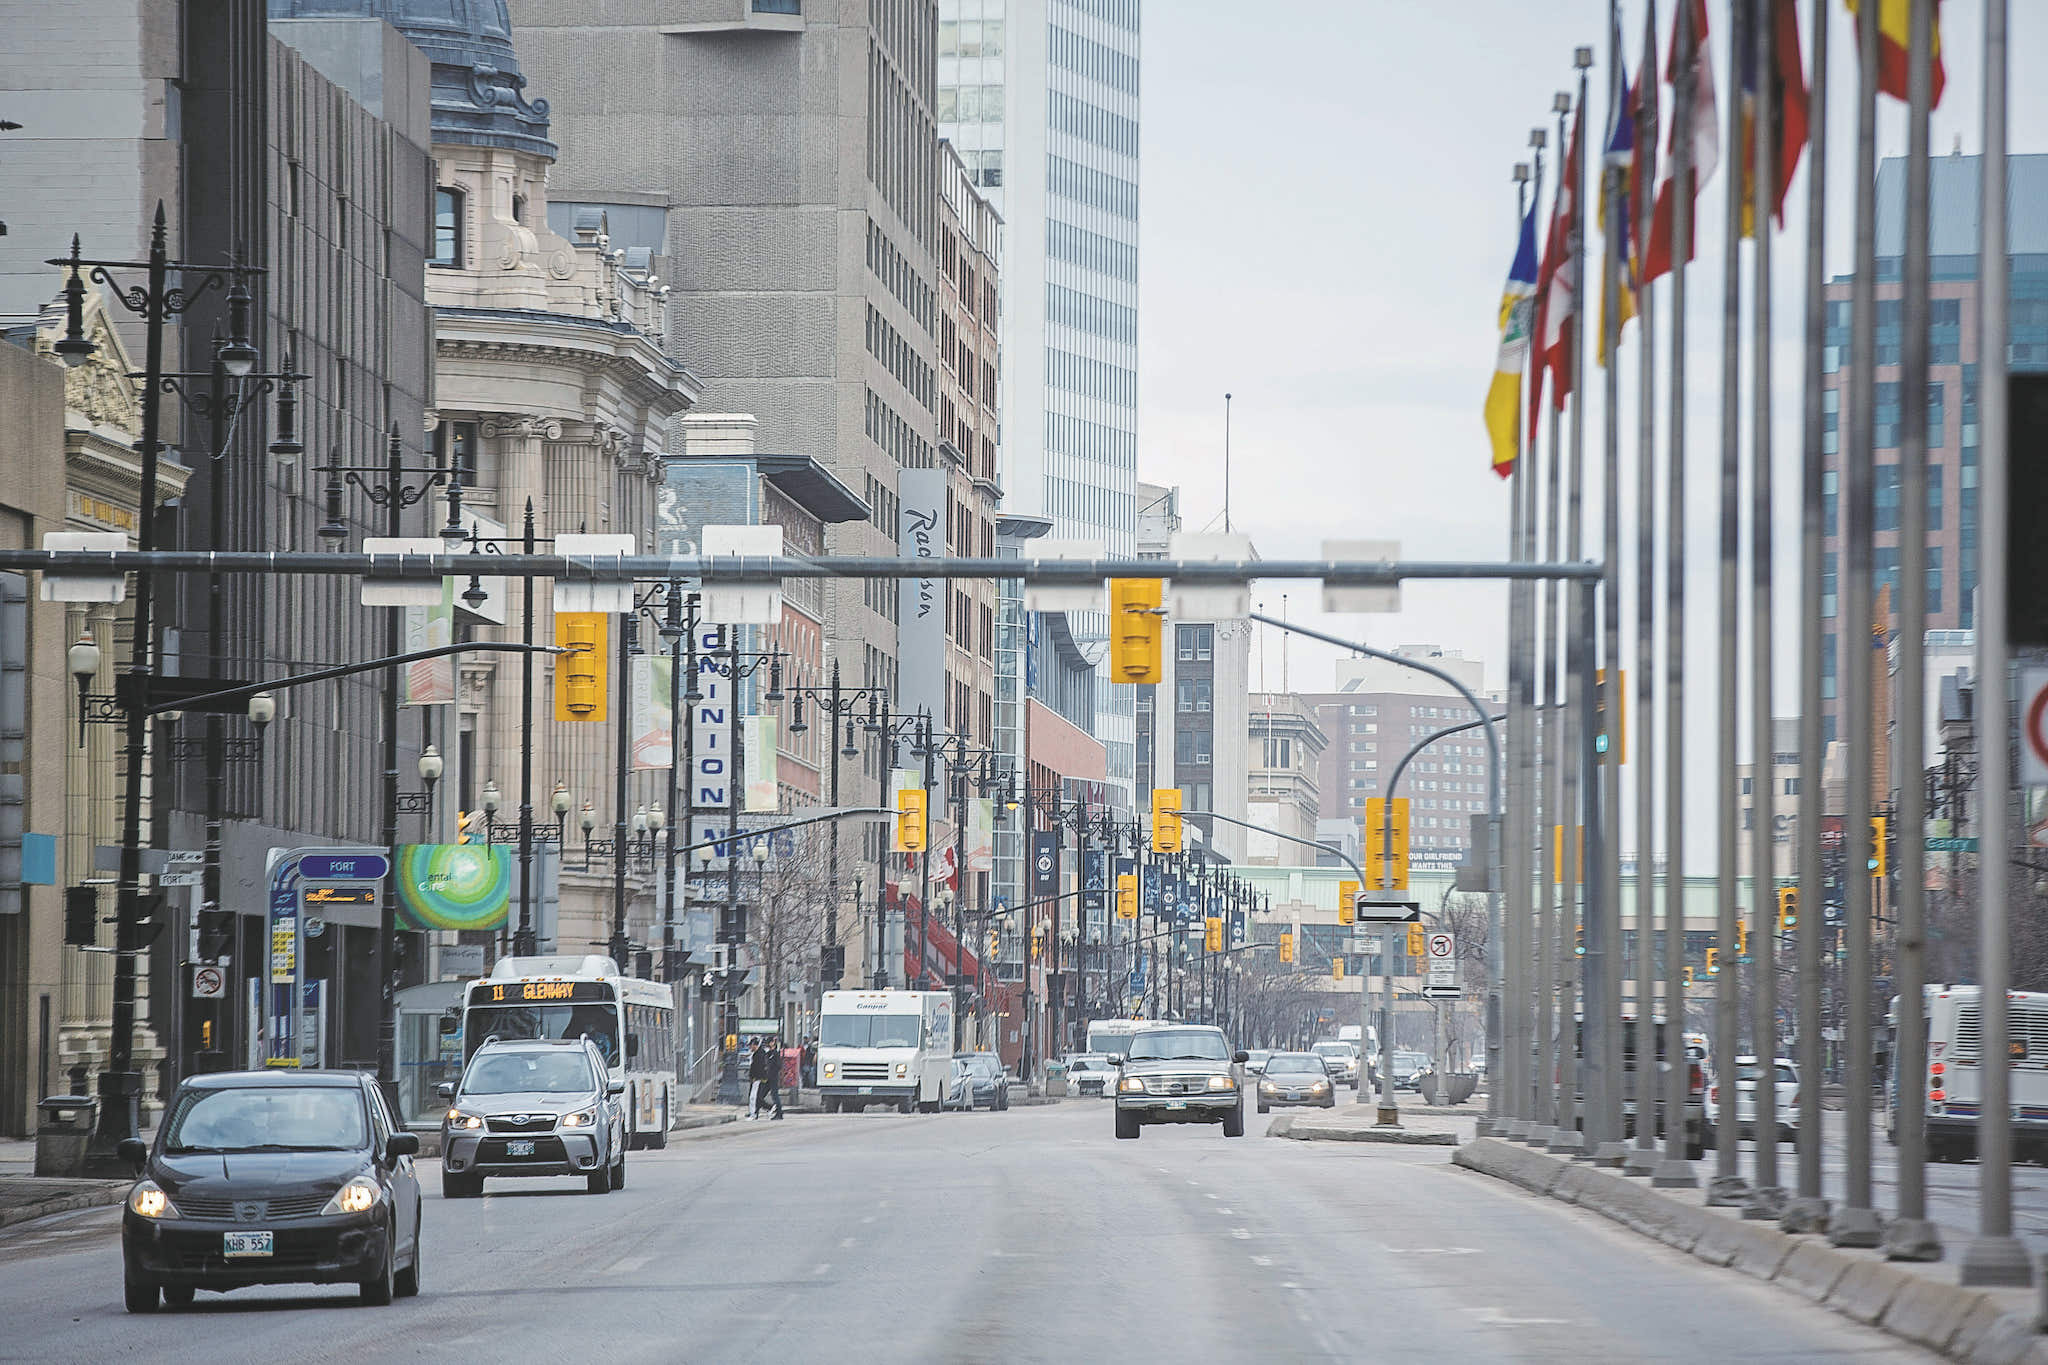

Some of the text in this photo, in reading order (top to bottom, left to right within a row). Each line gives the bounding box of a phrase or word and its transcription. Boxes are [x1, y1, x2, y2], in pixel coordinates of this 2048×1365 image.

[904, 508, 942, 619] Radson
[700, 622, 728, 803] OMINION
[329, 861, 356, 872] FORT
[492, 982, 575, 1001] 11 GLENWAY
[225, 1238, 271, 1251] KHB 557
